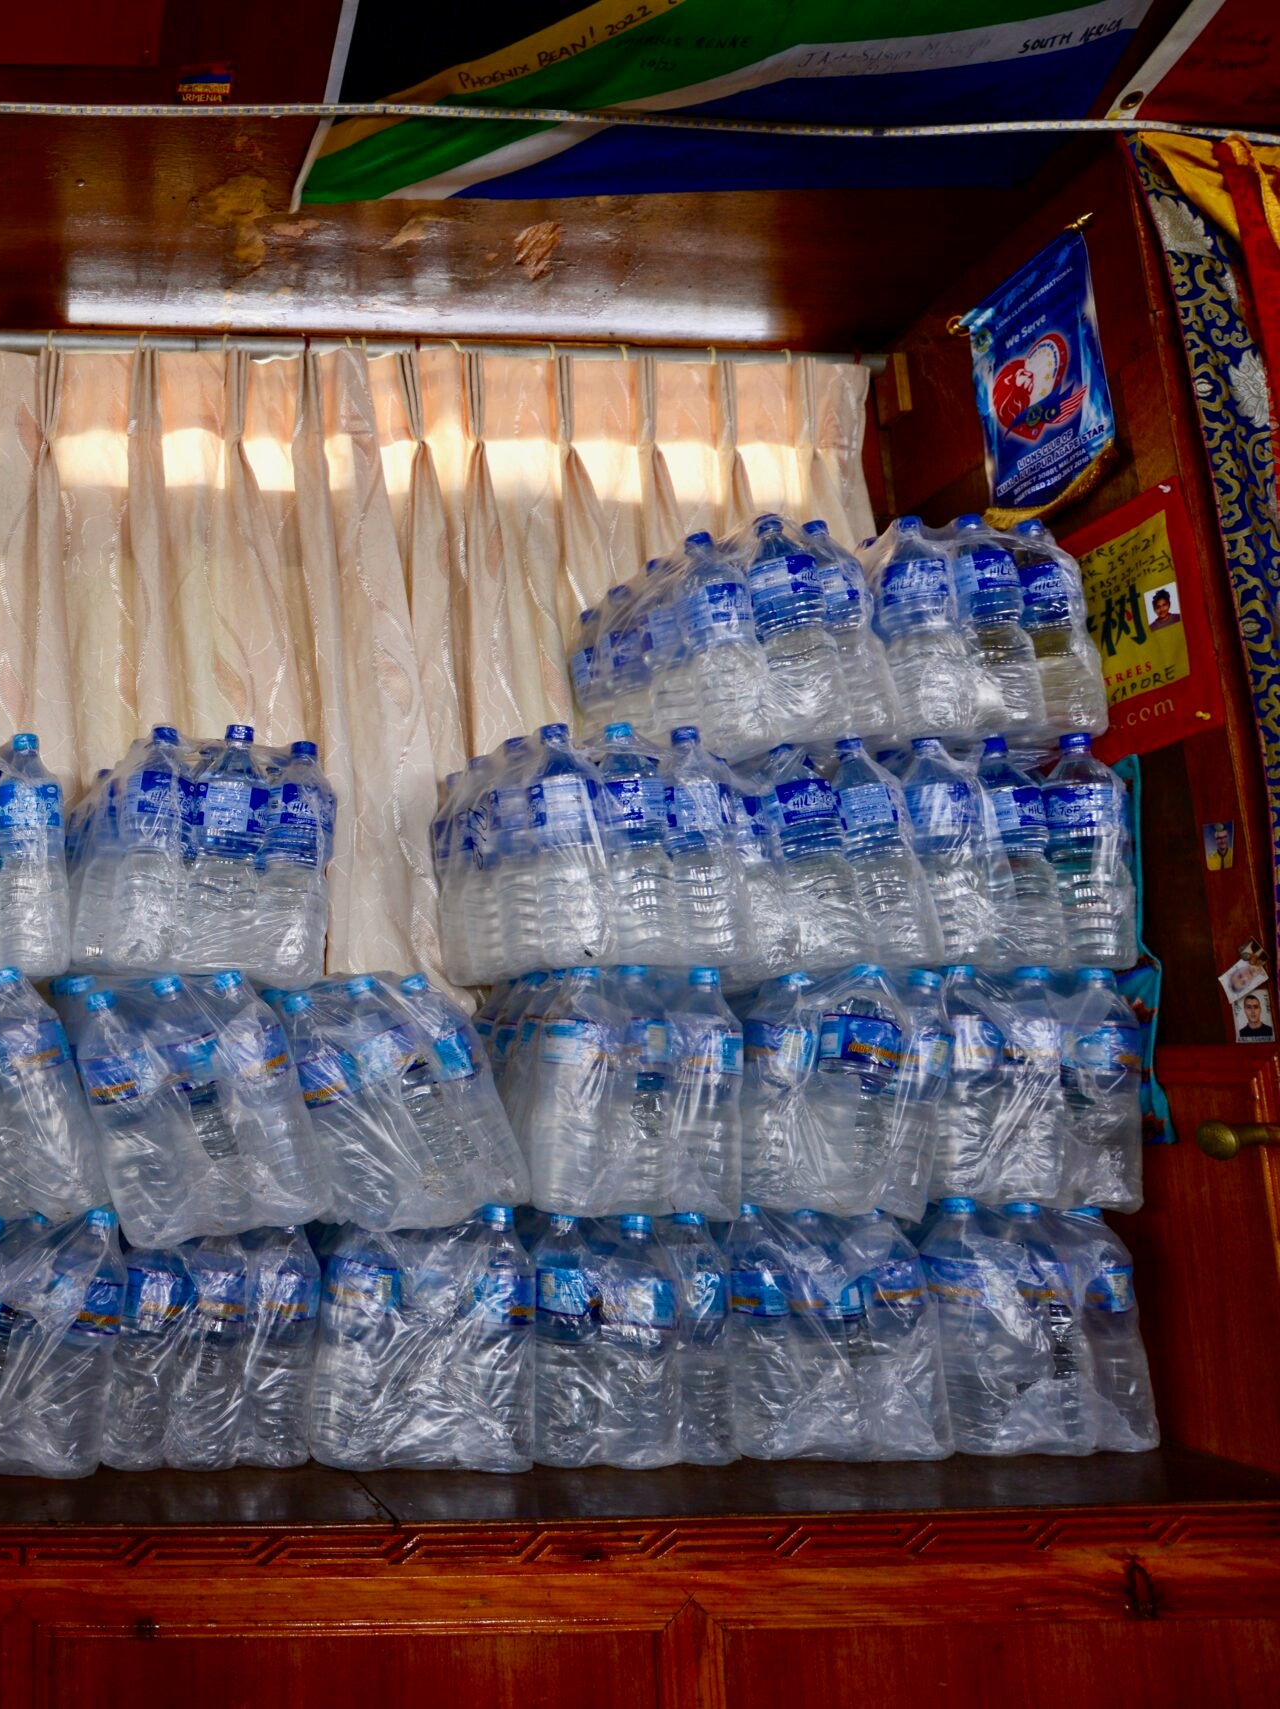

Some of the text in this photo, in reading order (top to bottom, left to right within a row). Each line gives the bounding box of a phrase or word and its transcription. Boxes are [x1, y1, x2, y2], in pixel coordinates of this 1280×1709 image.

[458, 5, 652, 89] PHOENIX BEAN! 2022
[1018, 31, 1073, 53] SOUTH
[1079, 18, 1123, 44] AFRICA
[1005, 314, 1047, 350] We Serve
[996, 424, 1105, 498] KUALA LUMPUR AGAPE STAR
[1017, 428, 1074, 471] LIONS CLUB OF
[1103, 660, 1153, 687] TREES
[1059, 805, 1081, 818] TOP
